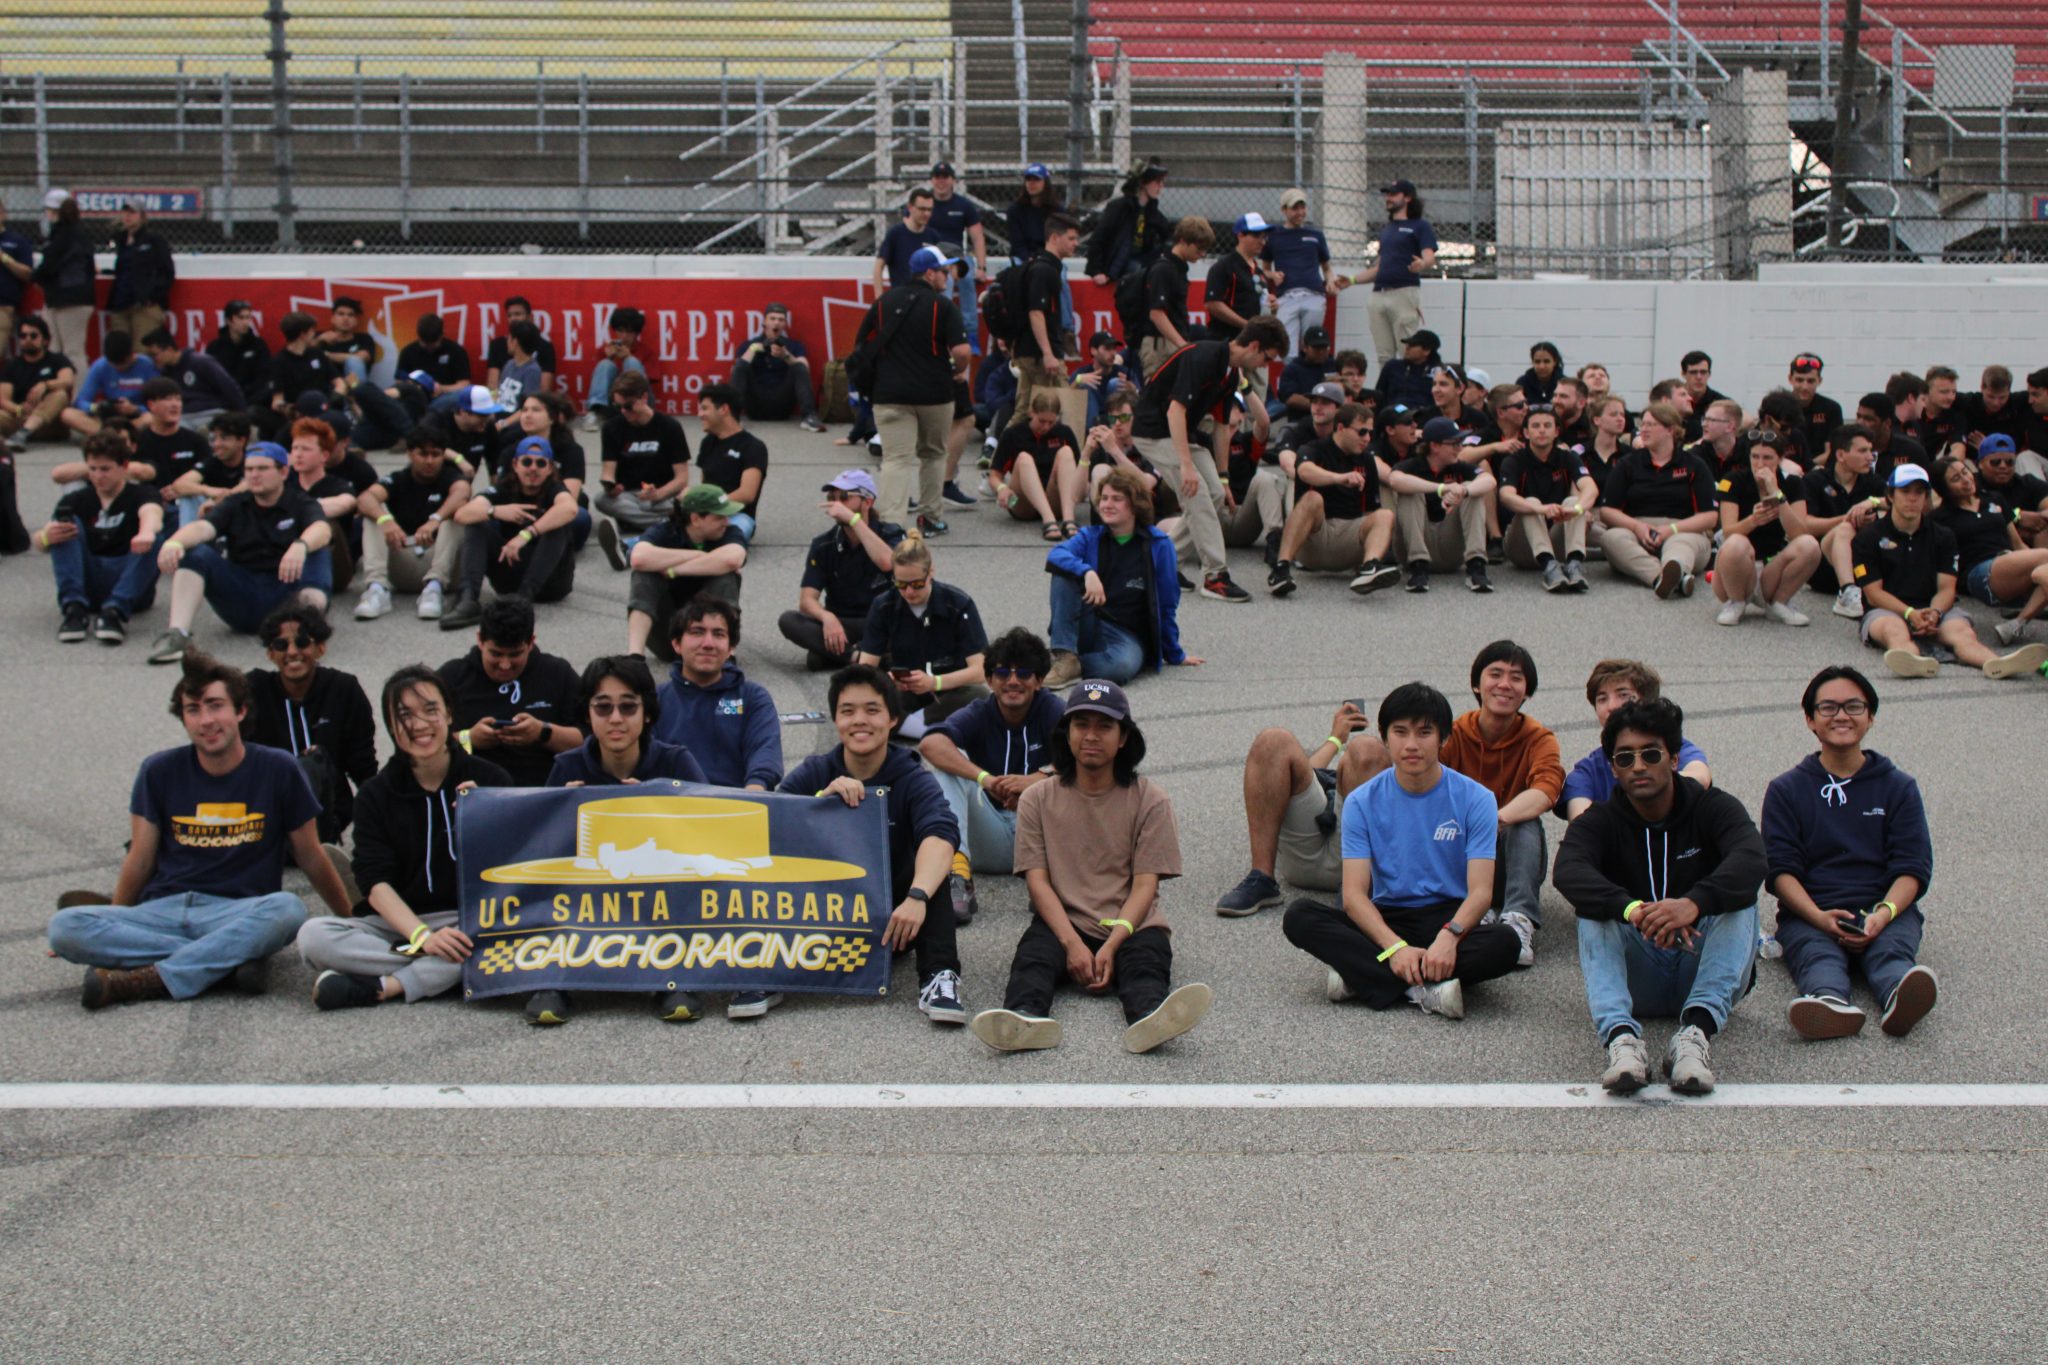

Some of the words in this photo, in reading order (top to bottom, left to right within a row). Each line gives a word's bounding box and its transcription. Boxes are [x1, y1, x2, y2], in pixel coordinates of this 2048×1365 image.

[171, 194, 184, 210] 2
[477, 303, 793, 361] FREKEPER
[662, 374, 723, 394] HOT
[1084, 683, 1110, 694] UCSB
[479, 895, 521, 928] UC
[552, 890, 670, 923] SANTA
[701, 888, 870, 924] BARBARA
